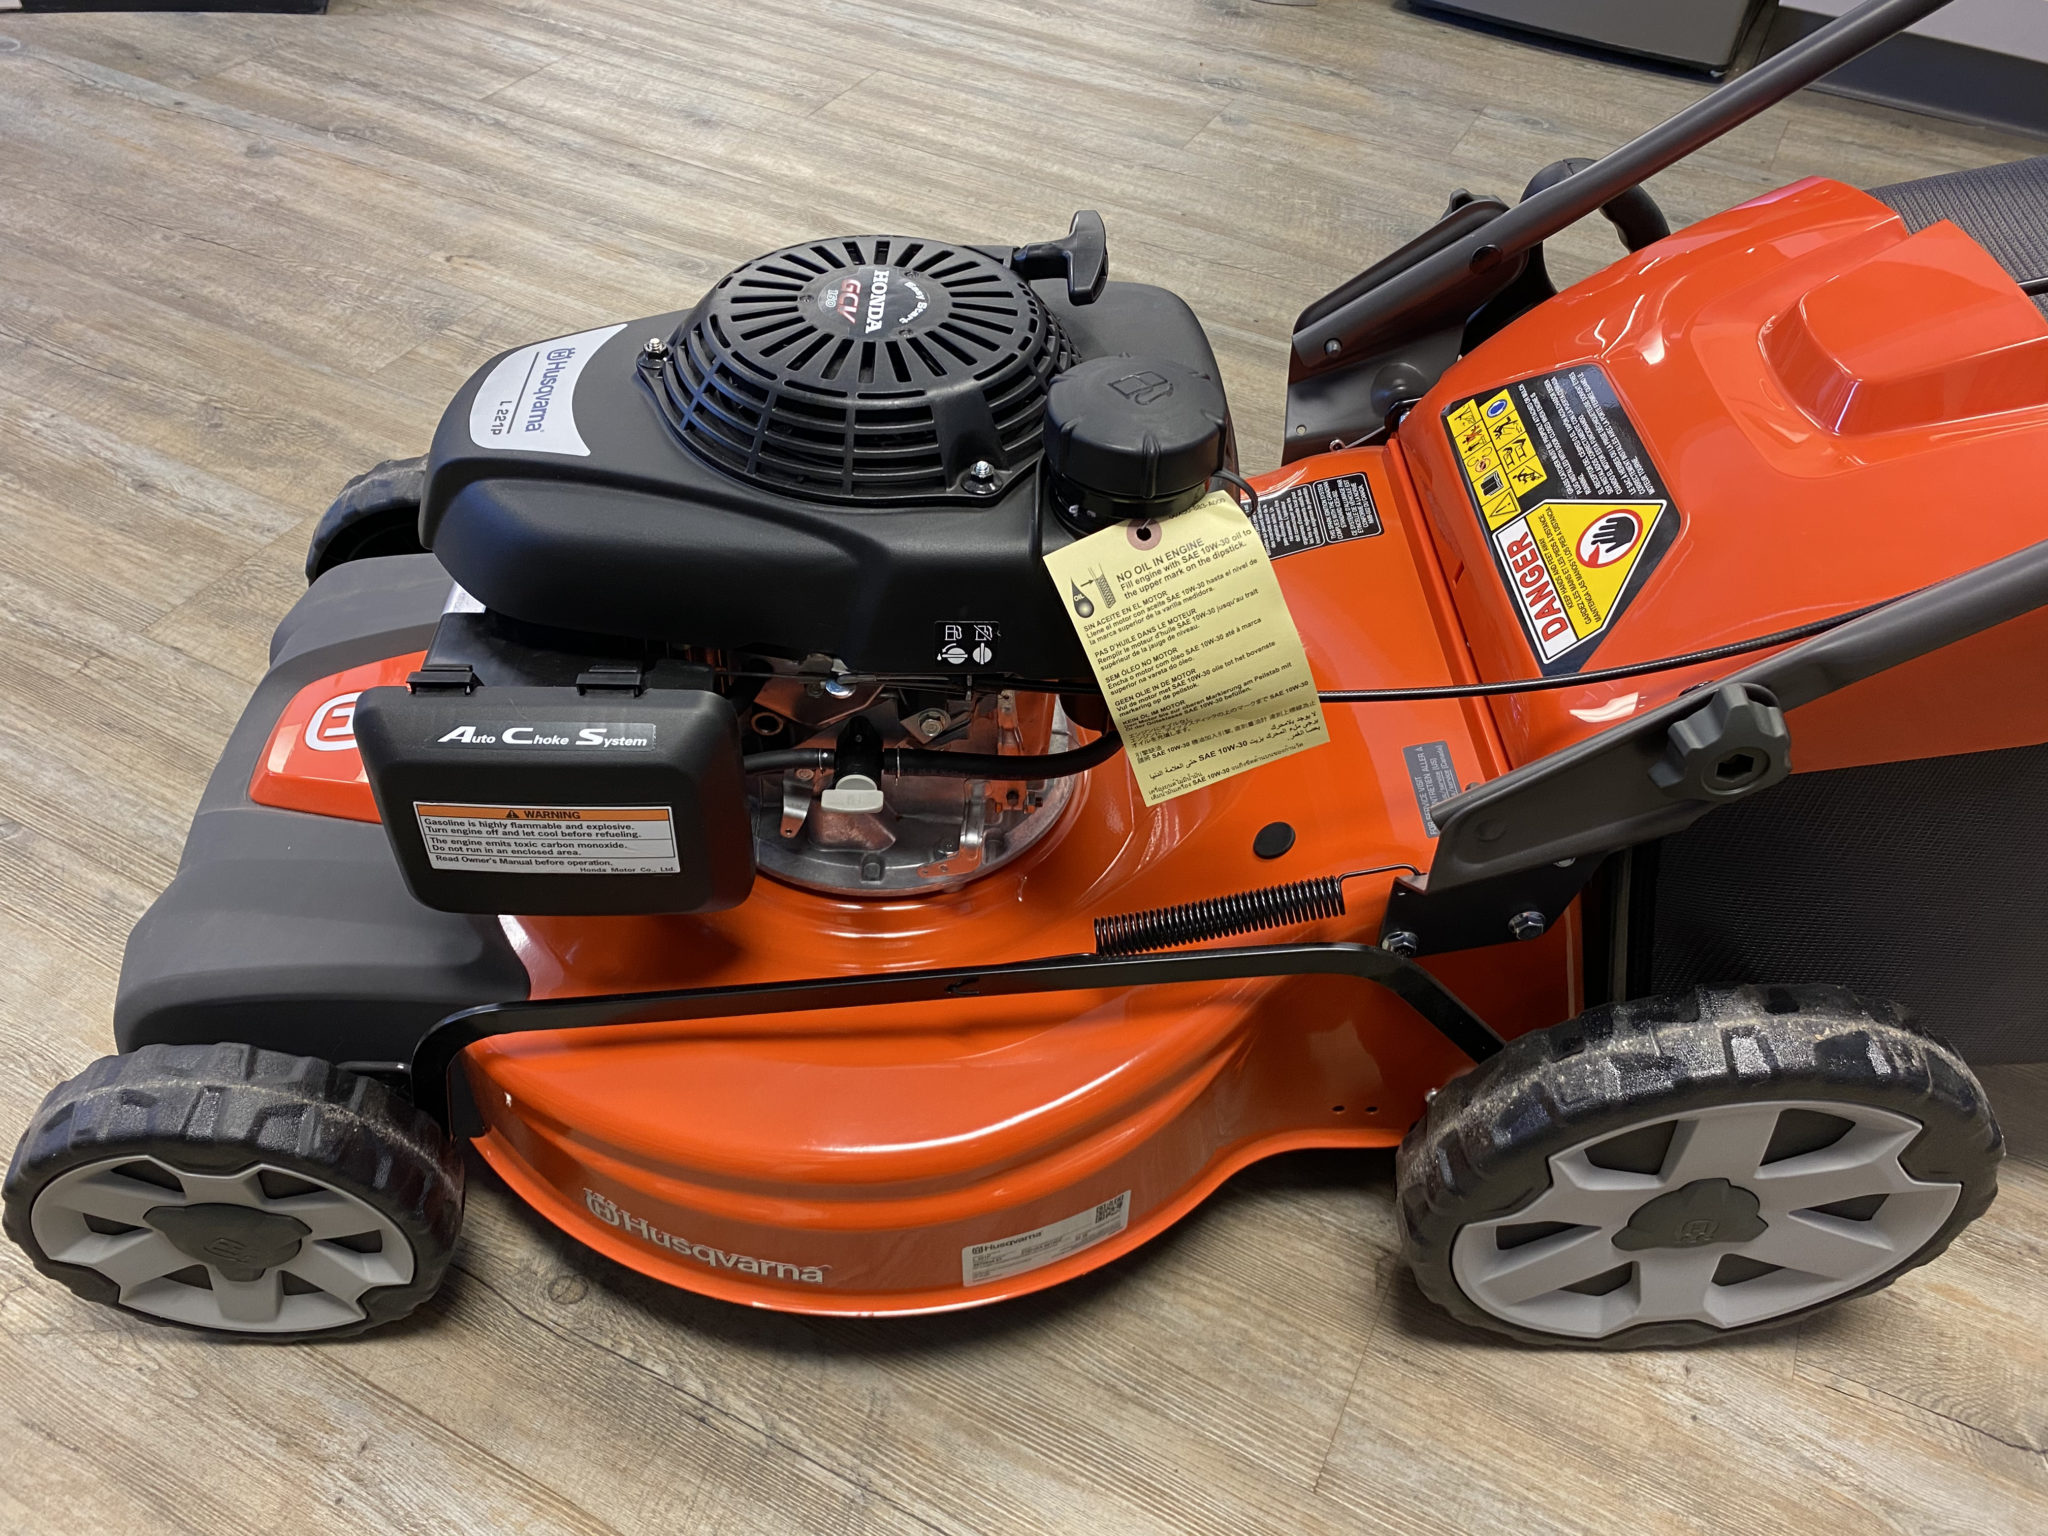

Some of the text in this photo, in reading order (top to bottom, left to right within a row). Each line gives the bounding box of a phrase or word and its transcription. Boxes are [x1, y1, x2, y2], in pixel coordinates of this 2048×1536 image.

[826, 289, 838, 308] 160
[838, 279, 862, 324] GCV
[864, 270, 889, 333] HONDA
[525, 360, 568, 432] Husqvarna
[1116, 537, 1204, 582] NO OIL IN ENGINE
[1120, 527, 1251, 590] Fill engine with SAE 10W-30 oil to
[1123, 539, 1247, 598] the upper mark on the dipstick.
[1538, 537, 1574, 609] KEEP HANDS AND FEET AWAY
[1072, 592, 1084, 601] OIL
[1086, 626, 1104, 638] Llene
[1112, 614, 1132, 627] motor
[1132, 609, 1145, 618] con
[1145, 599, 1165, 612] aceite
[1166, 592, 1180, 603] SAE
[1181, 581, 1205, 596] 10W-30
[1205, 572, 1224, 585] hasta
[1231, 561, 1248, 573] nivel
[1248, 557, 1257, 565] de
[1507, 532, 1568, 642] DANGER
[1083, 589, 1167, 631] SIN ACEITE EN EL MOTOR
[1094, 607, 1196, 657] PAS D'HUILE DANS LE MOTEUR
[1096, 630, 1116, 642] marca
[1117, 616, 1145, 634] superior
[1145, 612, 1153, 620] de
[1154, 608, 1161, 616] la
[1162, 599, 1181, 612] varilla
[1182, 584, 1214, 603] medidora.
[1097, 587, 1258, 666] Remplir le moteur d'huile SAE 10W-30 jusqu'au trait
[1131, 649, 1140, 657] de
[1148, 638, 1166, 651] jauge
[1166, 633, 1175, 641] de
[1176, 622, 1200, 637] niveau.
[1104, 672, 1120, 683] SEM
[1140, 658, 1152, 667] NO
[1152, 646, 1178, 662] MOTOR
[438, 726, 647, 748] Auto Choke System
[424, 818, 465, 826] Gasoline
[480, 821, 508, 830] highly
[510, 822, 562, 830] flammable
[426, 826, 448, 834] Turn
[450, 828, 482, 836] engine
[524, 810, 580, 820] WARNING
[462, 856, 497, 864] Owner's
[620, 1210, 824, 1284] Husqvarna
[984, 1231, 1042, 1251] Husqvarna
